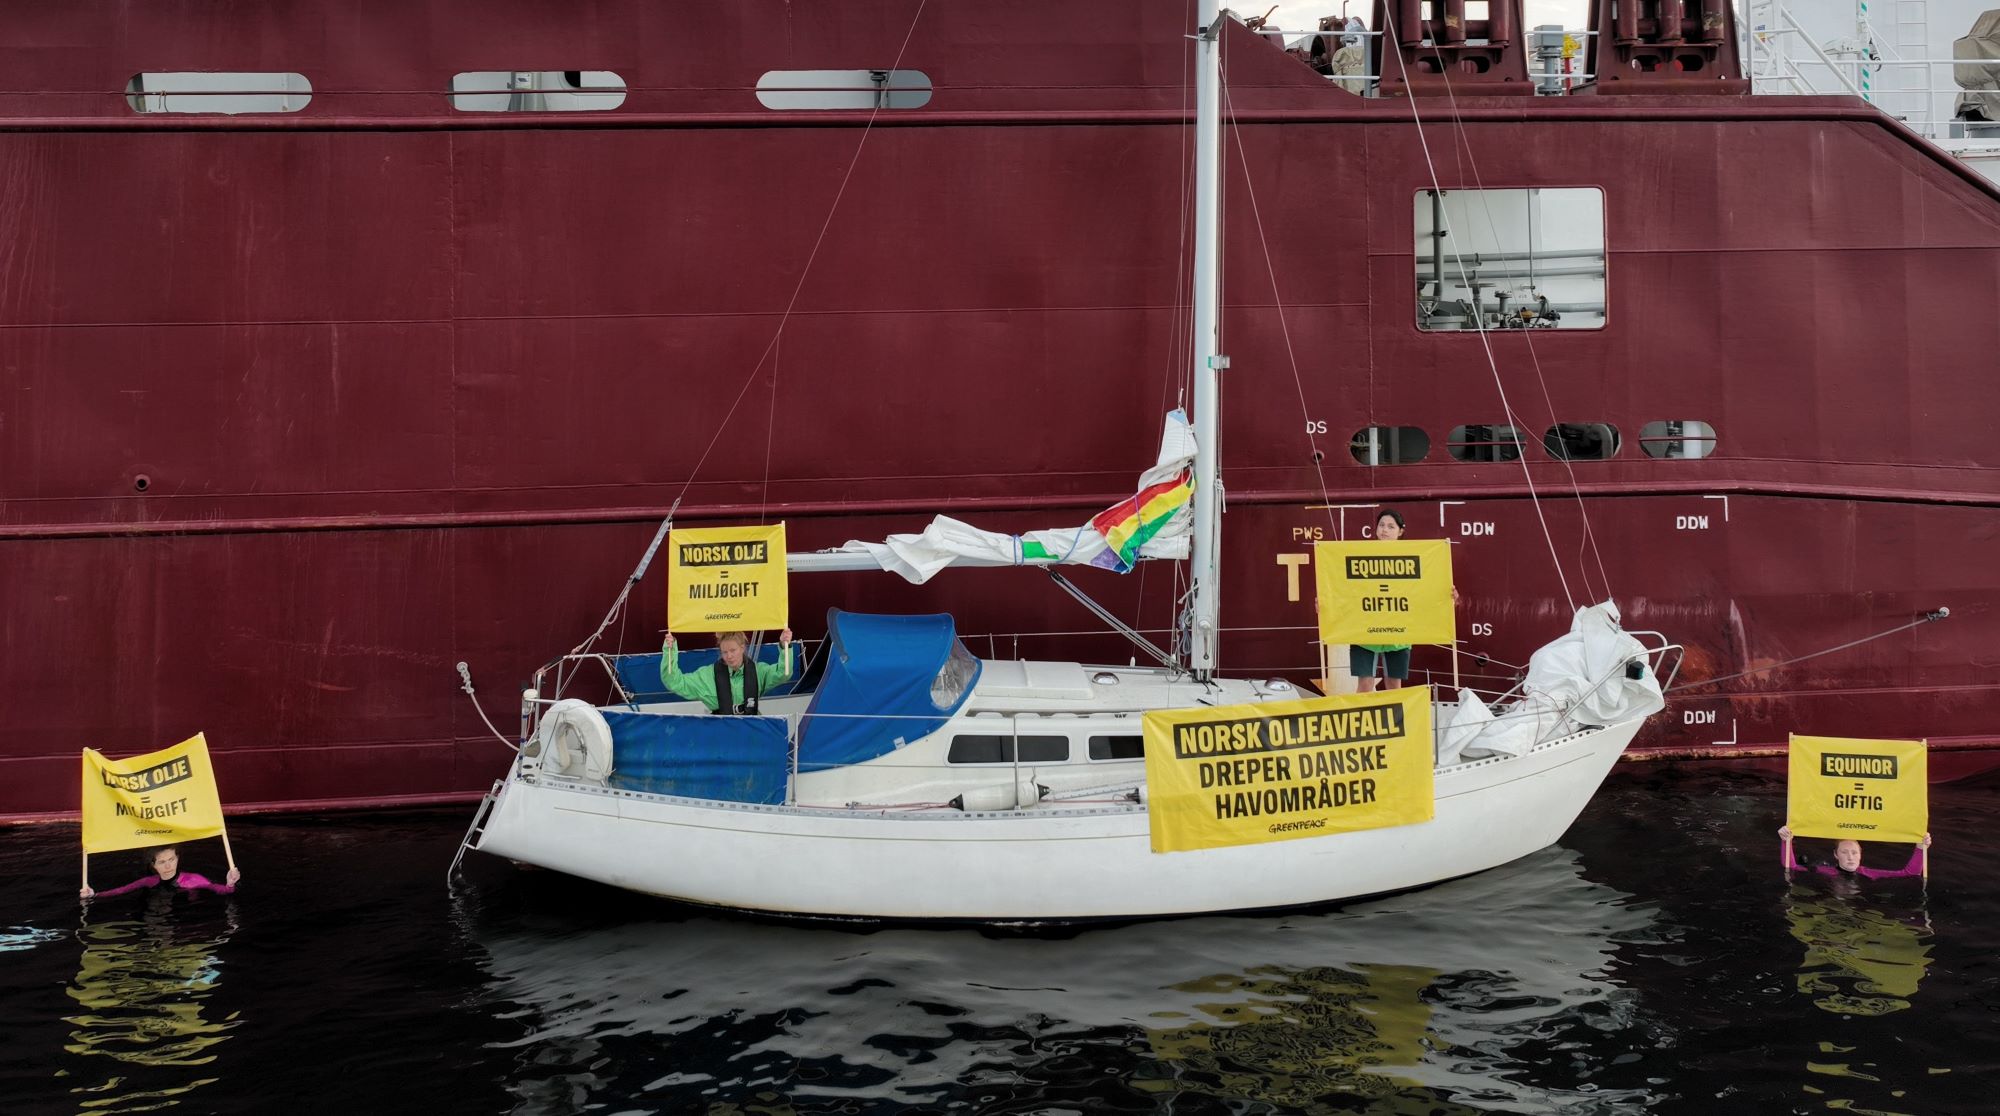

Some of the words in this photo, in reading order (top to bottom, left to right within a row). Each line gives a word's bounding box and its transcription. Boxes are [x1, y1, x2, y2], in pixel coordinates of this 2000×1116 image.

[1306, 421, 1327, 434] DS
[1461, 522, 1495, 536] DDW
[1676, 515, 1709, 530] DDW
[1292, 527, 1324, 541] PWS
[682, 547, 731, 563] NORSK
[734, 544, 764, 561] OLJE
[1350, 559, 1416, 578] EQUINOR
[689, 582, 759, 599] MILJØGIFT
[1362, 597, 1409, 612] GIFTIG
[704, 613, 743, 621] GREENPEACE
[1366, 626, 1407, 634] GREENPEACE
[1472, 623, 1493, 636] DS
[1683, 710, 1716, 724] DDW
[1180, 721, 1263, 755] NORSK
[1268, 707, 1400, 748] OLJEAVFALL
[152, 759, 188, 785] OLJE
[1199, 756, 1291, 789] DREPER
[1299, 745, 1388, 780] DANSKE
[1826, 756, 1893, 776] EQUINOR
[1215, 778, 1376, 820] HAVOMRÅDER
[1834, 794, 1883, 811] GIFTIG
[1268, 817, 1328, 834] GREENPEACE
[1836, 822, 1878, 830] GREENPEACE
